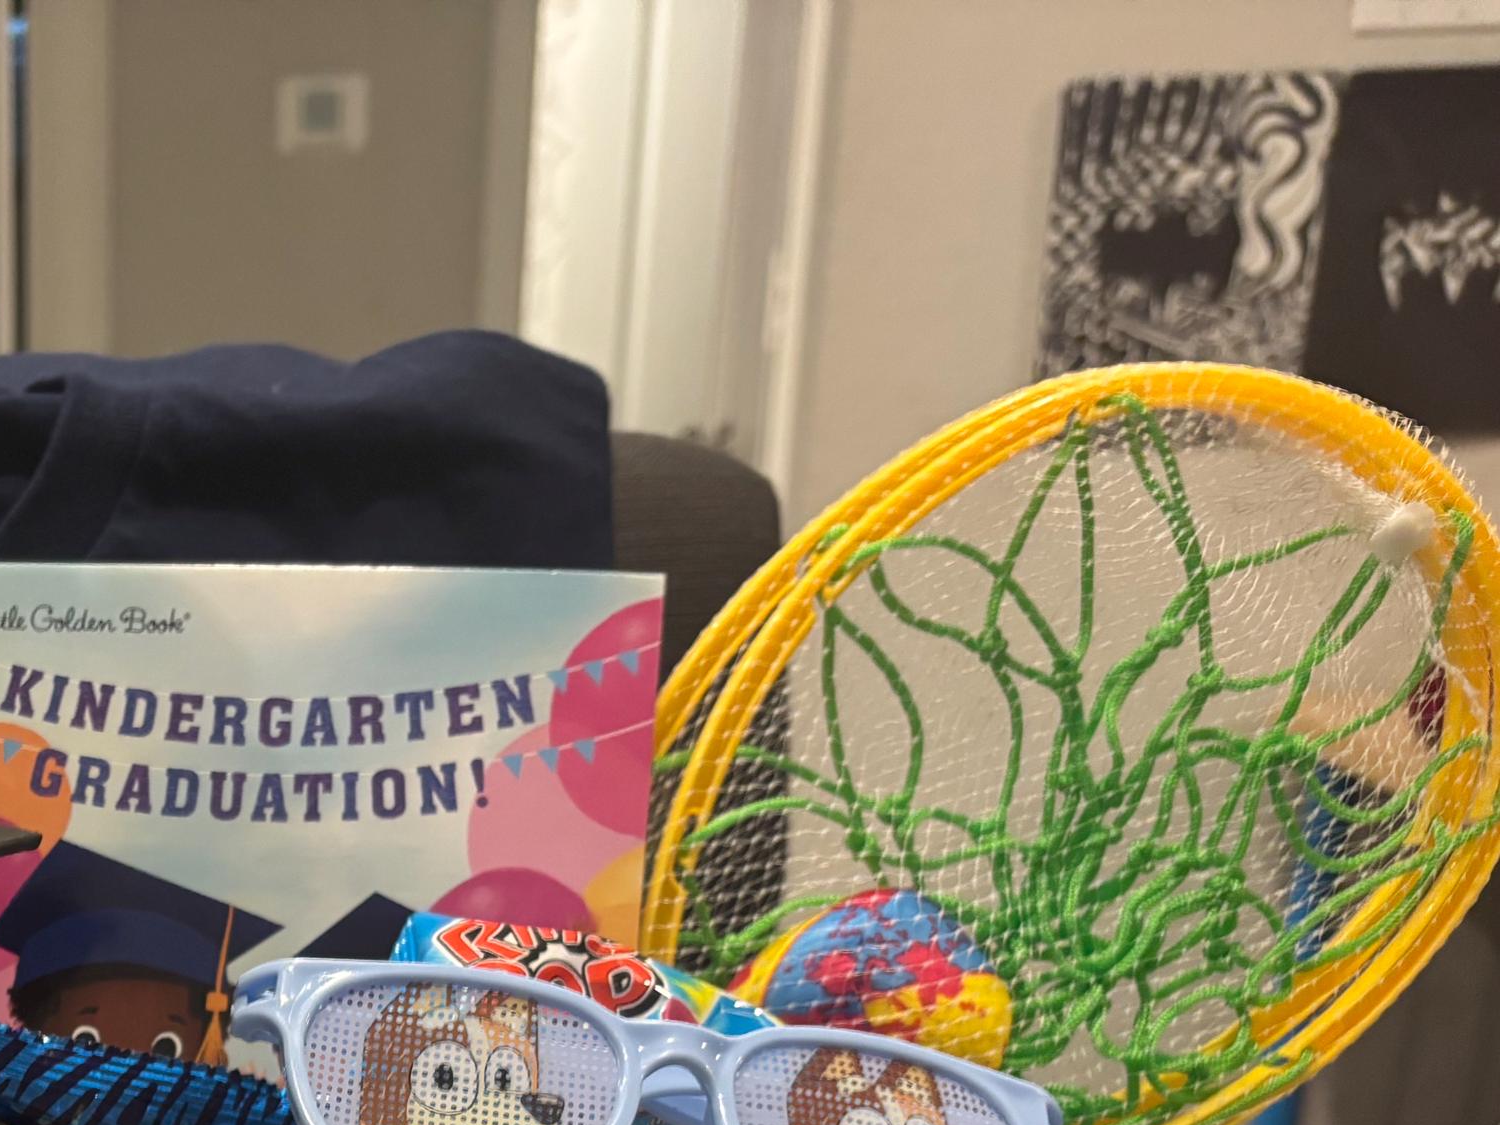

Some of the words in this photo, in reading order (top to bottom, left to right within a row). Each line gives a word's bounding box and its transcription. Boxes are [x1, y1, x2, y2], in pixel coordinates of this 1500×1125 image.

[30, 603, 116, 633] Golden
[0, 664, 535, 747] KINDERGARTEN
[31, 748, 490, 823] GRADUATION!
